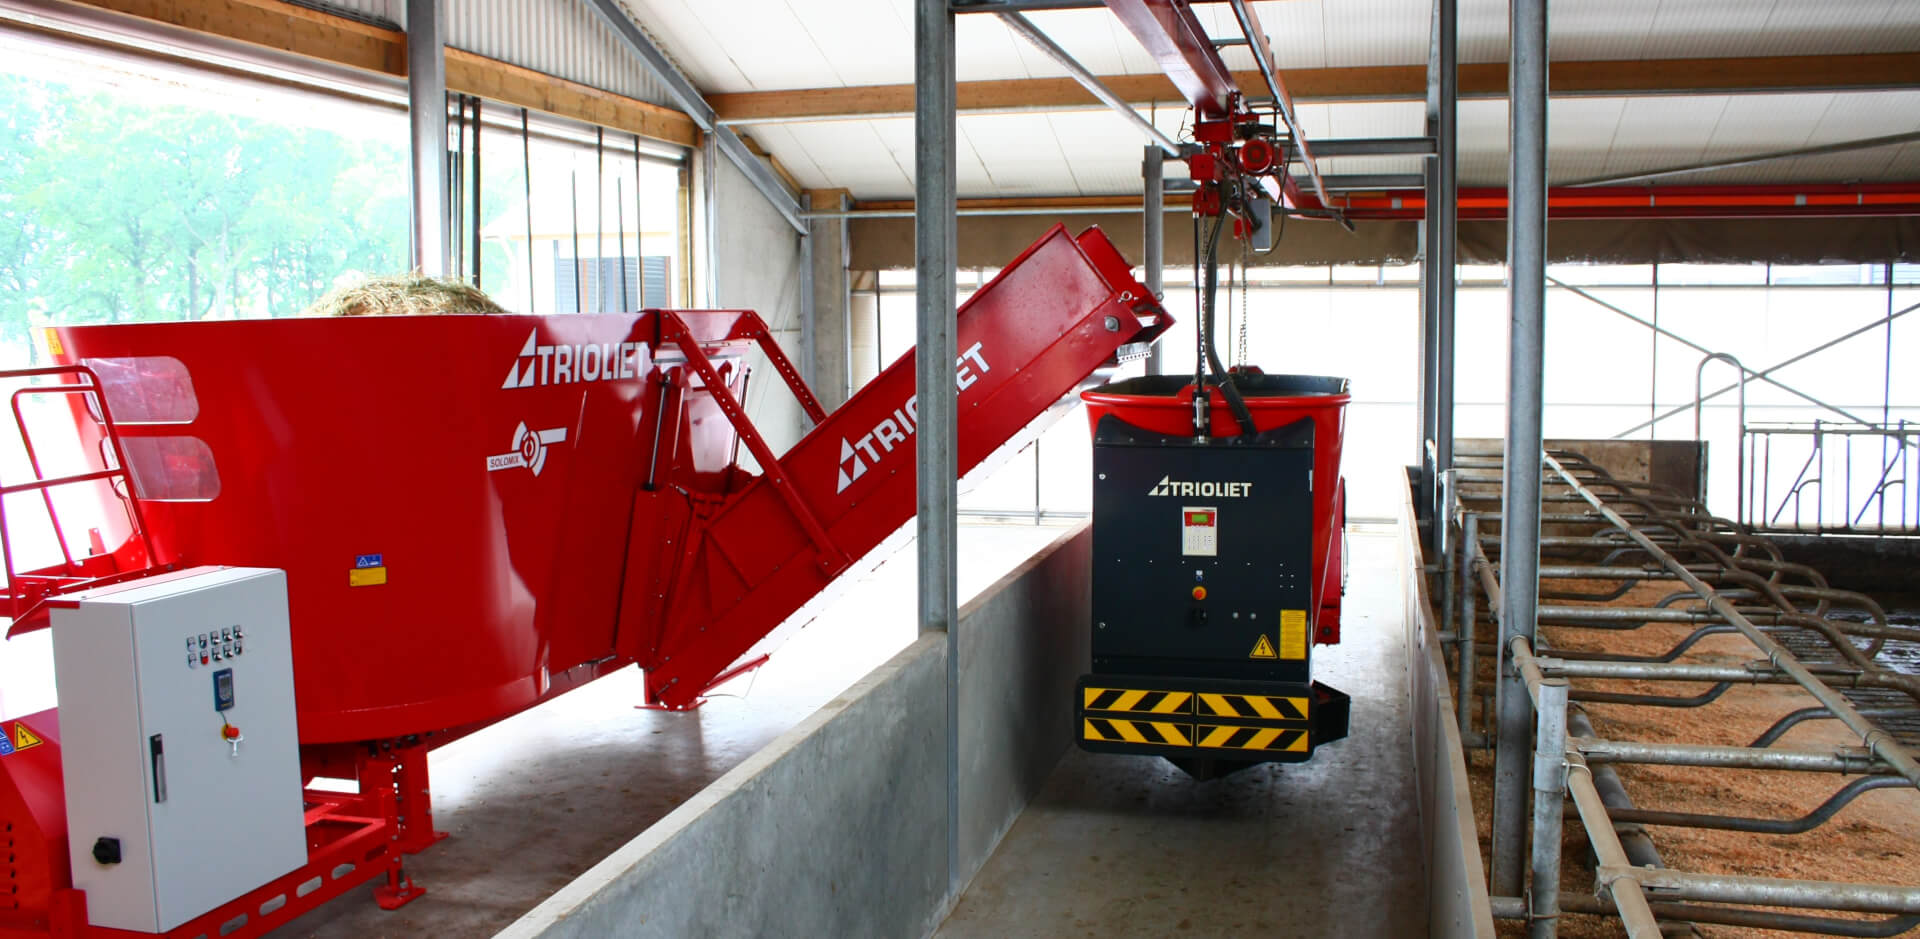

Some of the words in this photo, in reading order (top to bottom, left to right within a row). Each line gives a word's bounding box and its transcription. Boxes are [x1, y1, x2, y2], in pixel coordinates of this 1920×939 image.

[537, 341, 648, 386] TRIOLIET
[490, 455, 519, 468] SOLOMIX
[1169, 481, 1252, 497] TRIOLIET
